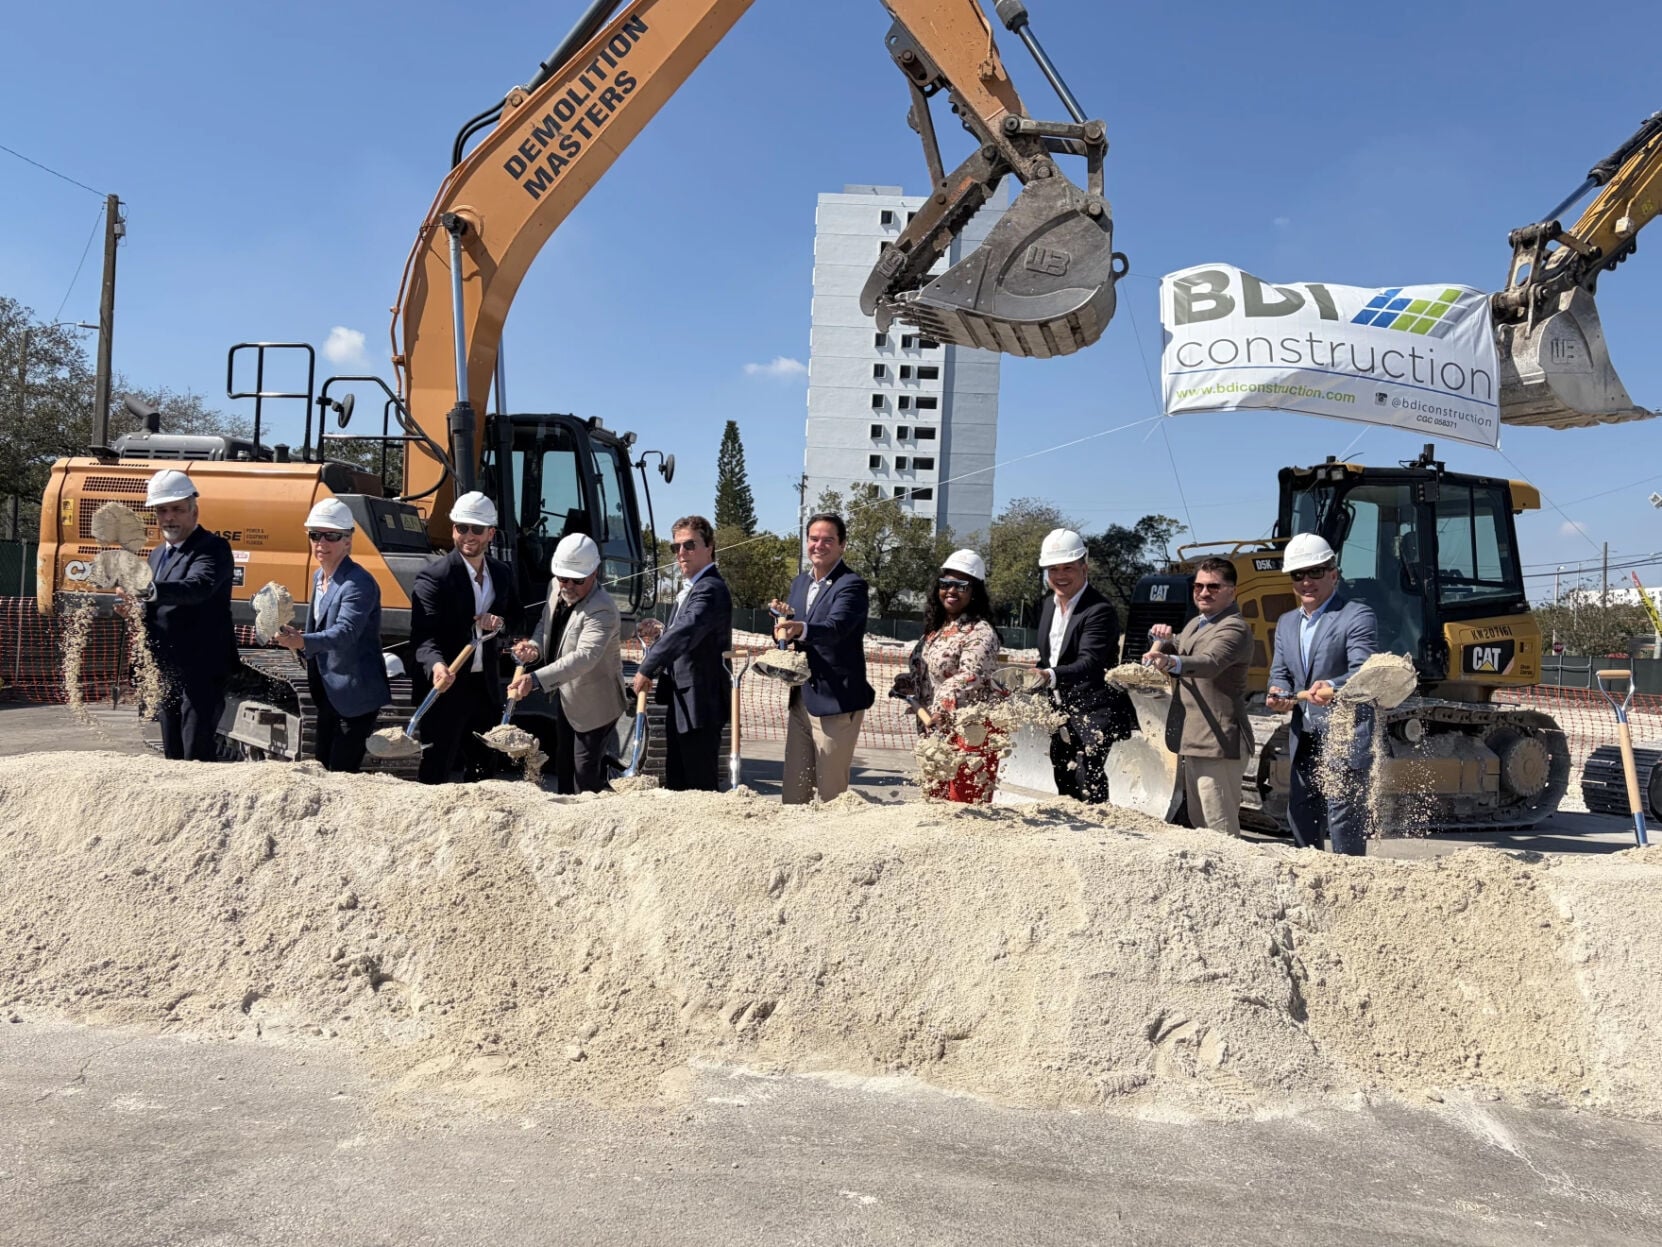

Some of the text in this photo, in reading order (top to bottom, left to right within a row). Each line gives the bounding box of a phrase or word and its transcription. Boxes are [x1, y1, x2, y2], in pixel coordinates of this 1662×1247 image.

[503, 14, 649, 181] DEMOLITION
[522, 70, 637, 200] MASTERS
[1173, 270, 1339, 326] BDI
[1176, 332, 1492, 399] construction
[1176, 382, 1356, 404] www.bdiconstruction.com
[1391, 397, 1492, 428] @bdiconstruction
[1416, 414, 1433, 424] CGC
[214, 530, 242, 541] ASE
[1150, 584, 1169, 601] CAT
[1472, 646, 1502, 672] CAT
